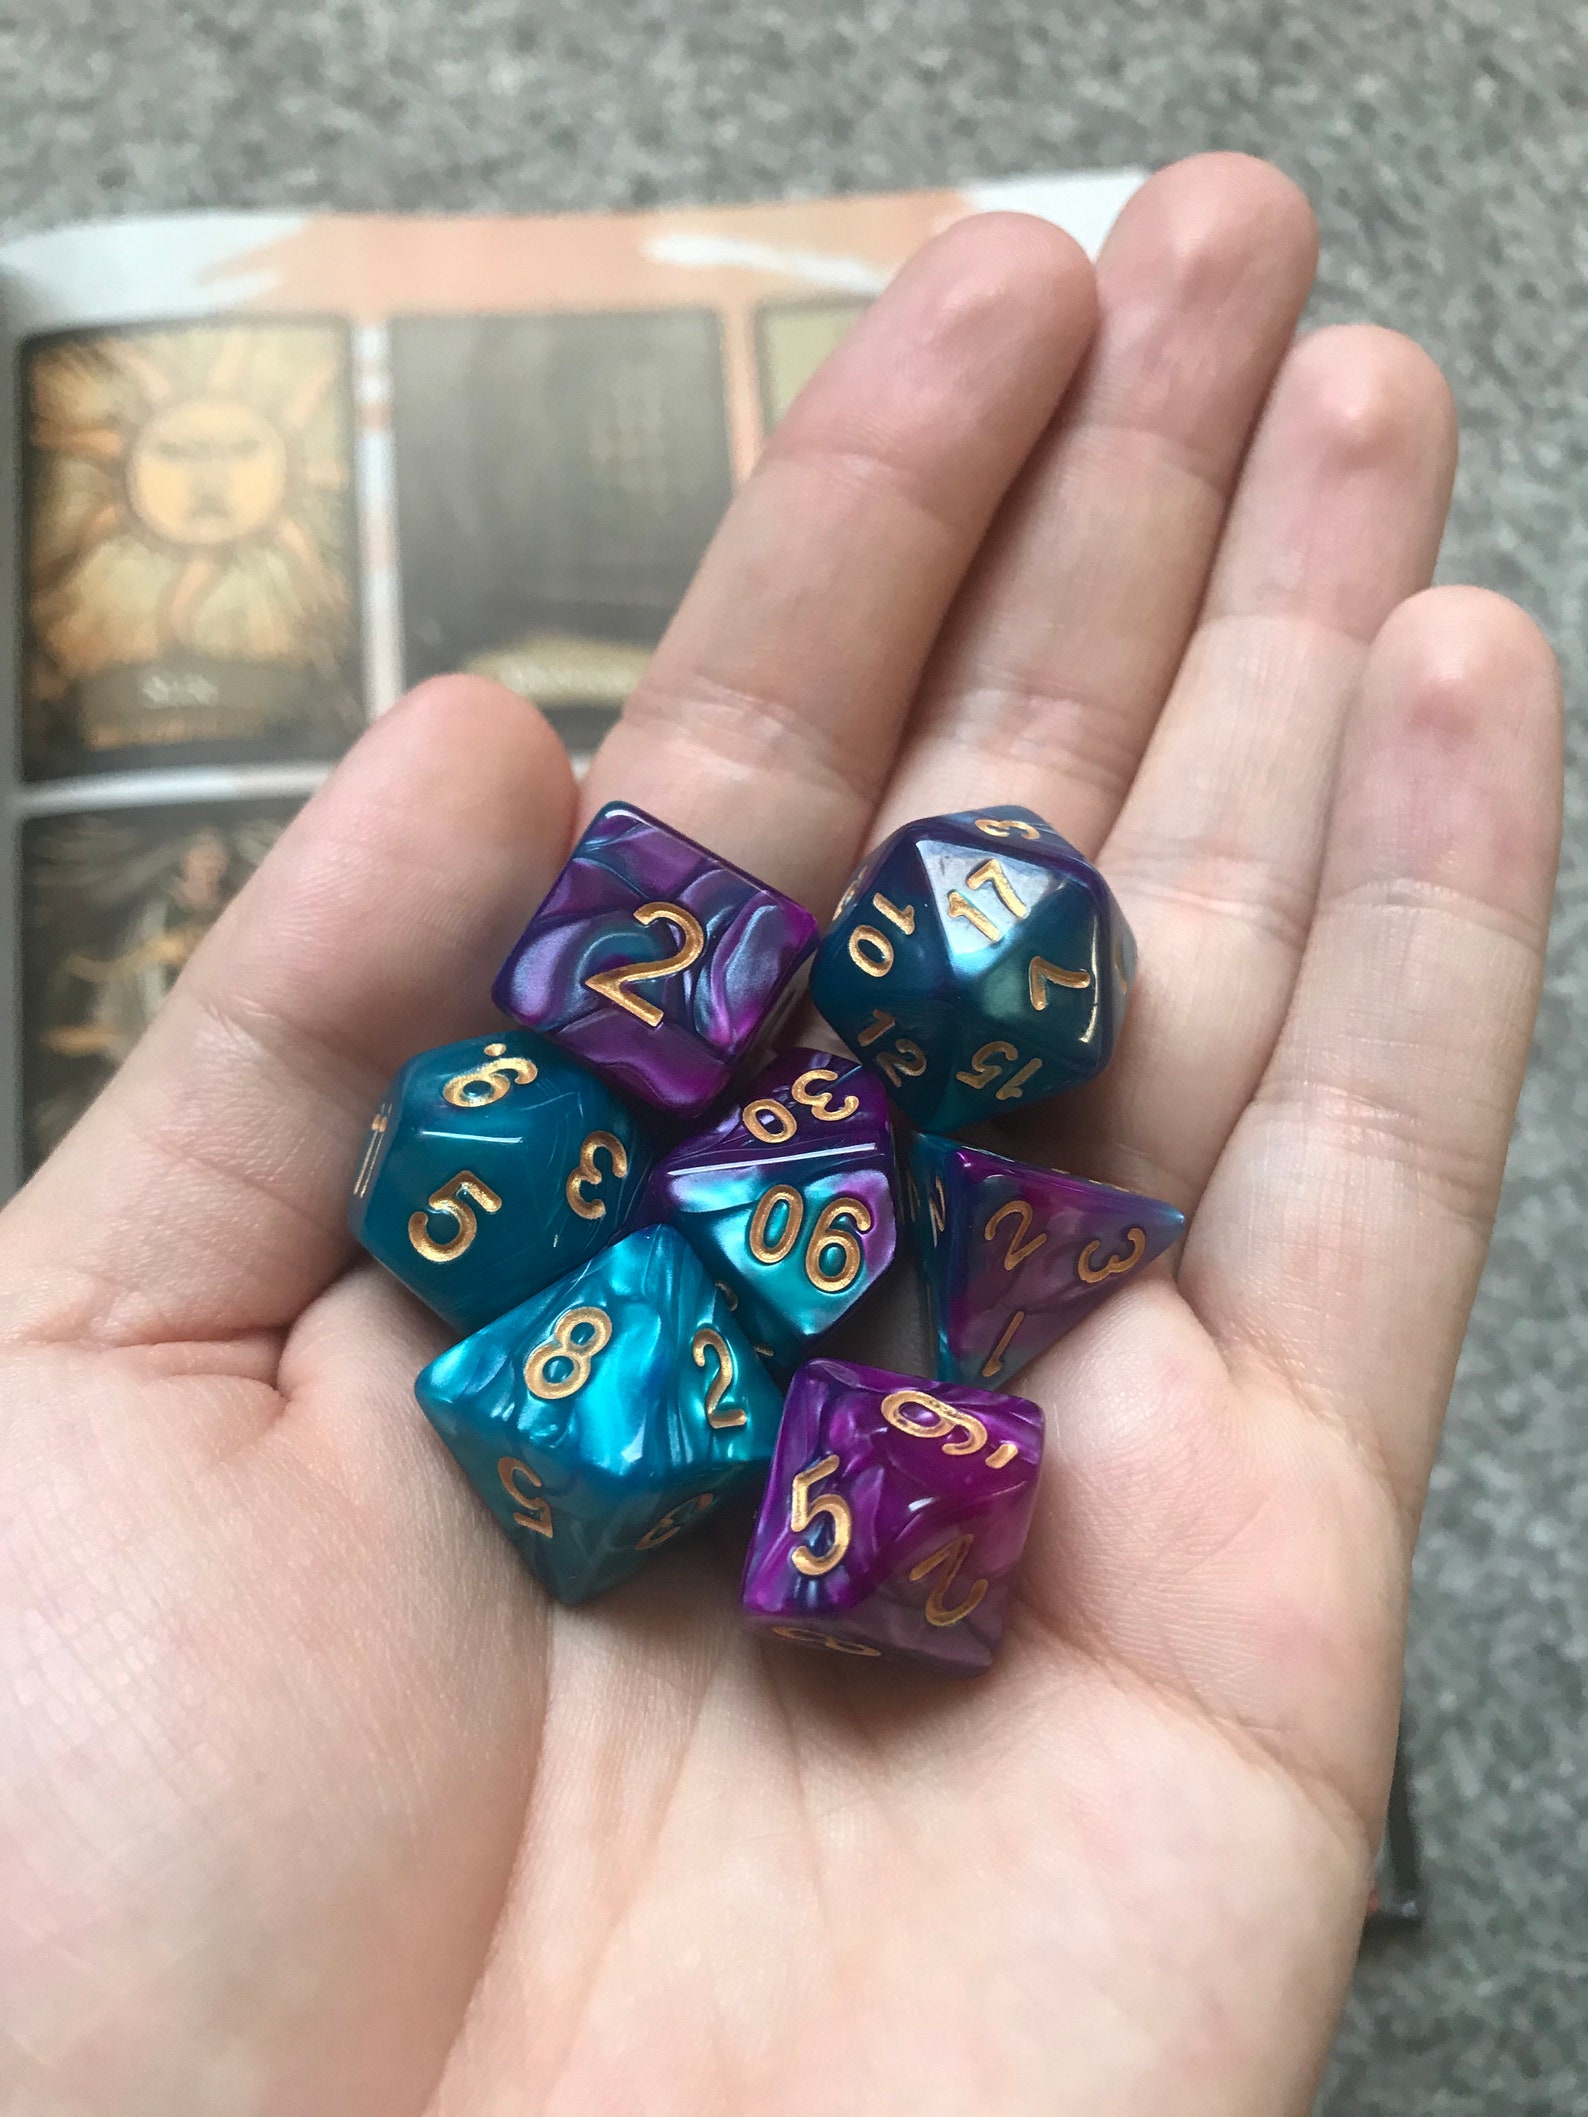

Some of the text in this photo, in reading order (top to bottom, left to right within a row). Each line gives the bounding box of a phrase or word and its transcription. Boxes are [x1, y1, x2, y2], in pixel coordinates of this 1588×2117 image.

[849, 892, 915, 978] 10
[949, 859, 1028, 942] 17
[585, 901, 705, 1028] 2
[1029, 956, 1091, 1011] 7
[858, 1008, 928, 1088] 12
[956, 1040, 1043, 1100] 15
[408, 1169, 503, 1262] 5
[566, 1130, 628, 1220] 3
[984, 1199, 1048, 1271] 2
[1077, 1227, 1146, 1283] 3
[524, 1306, 613, 1400] 8
[692, 1327, 747, 1429] 2
[498, 1456, 554, 1539] 5
[791, 1454, 852, 1576] 5
[909, 1533, 989, 1627] 2
